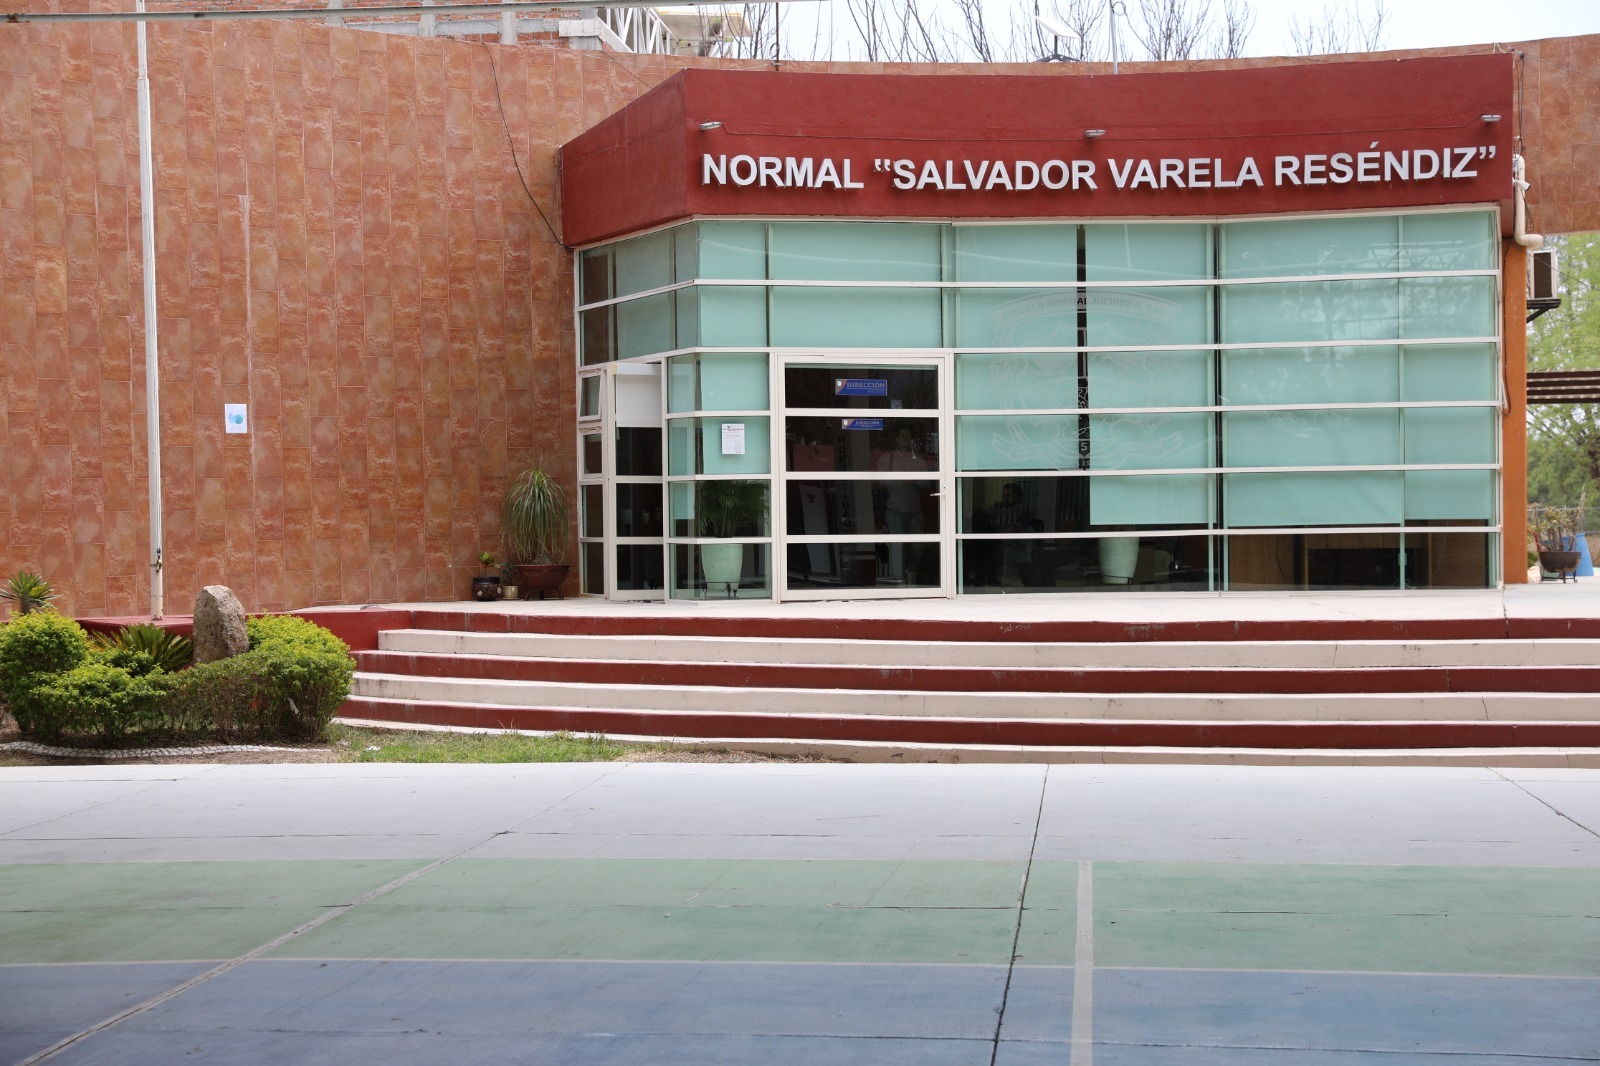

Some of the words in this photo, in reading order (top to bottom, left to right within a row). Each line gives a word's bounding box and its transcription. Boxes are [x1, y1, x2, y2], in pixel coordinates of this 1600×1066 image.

[702, 153, 864, 189] NORMAL
[873, 158, 1098, 191] “SALVADOR
[1107, 156, 1264, 189] VARELA
[1274, 141, 1497, 186] RESÉNDIZ”
[1003, 302, 1045, 320] ESCUELA
